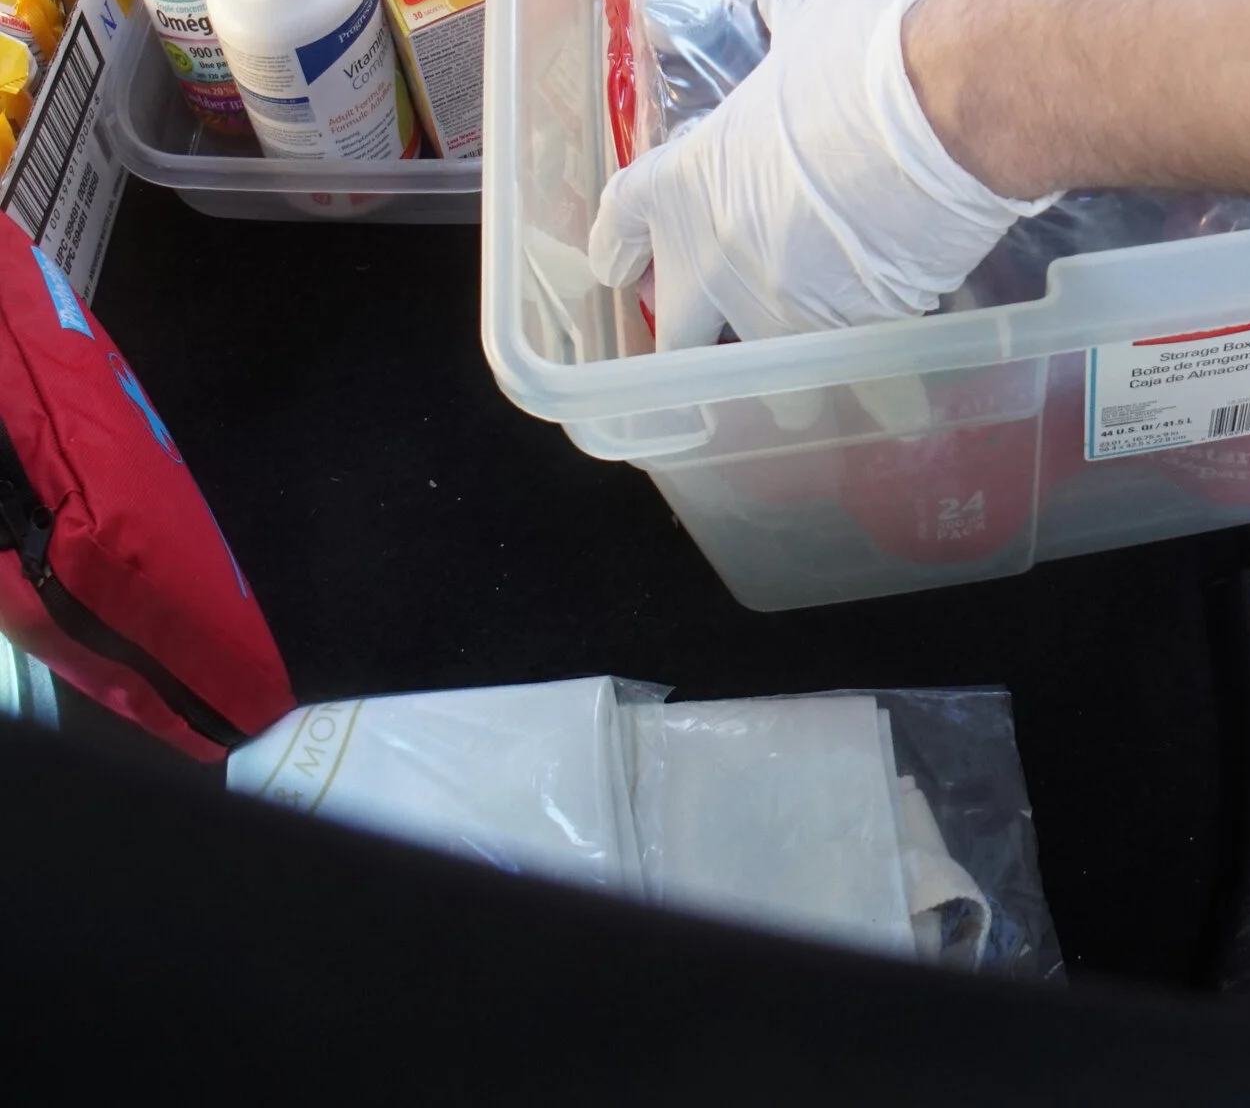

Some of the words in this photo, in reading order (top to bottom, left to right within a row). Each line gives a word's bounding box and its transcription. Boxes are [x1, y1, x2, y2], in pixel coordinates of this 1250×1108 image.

[156, 9, 214, 35] Omég
[189, 47, 213, 58] 900
[342, 26, 385, 79] Vitamin
[328, 108, 354, 127] Adult
[330, 109, 369, 134] Formule
[55, 240, 71, 269] UPC
[64, 201, 81, 239] 59491
[62, 247, 77, 276] UPC
[71, 212, 89, 252] 59491
[1160, 345, 1220, 363] Storage
[1129, 376, 1162, 390] Caja
[1166, 371, 1185, 383] de
[1131, 365, 1170, 378] Boîte
[1173, 361, 1193, 372] de
[937, 489, 985, 520] 24
